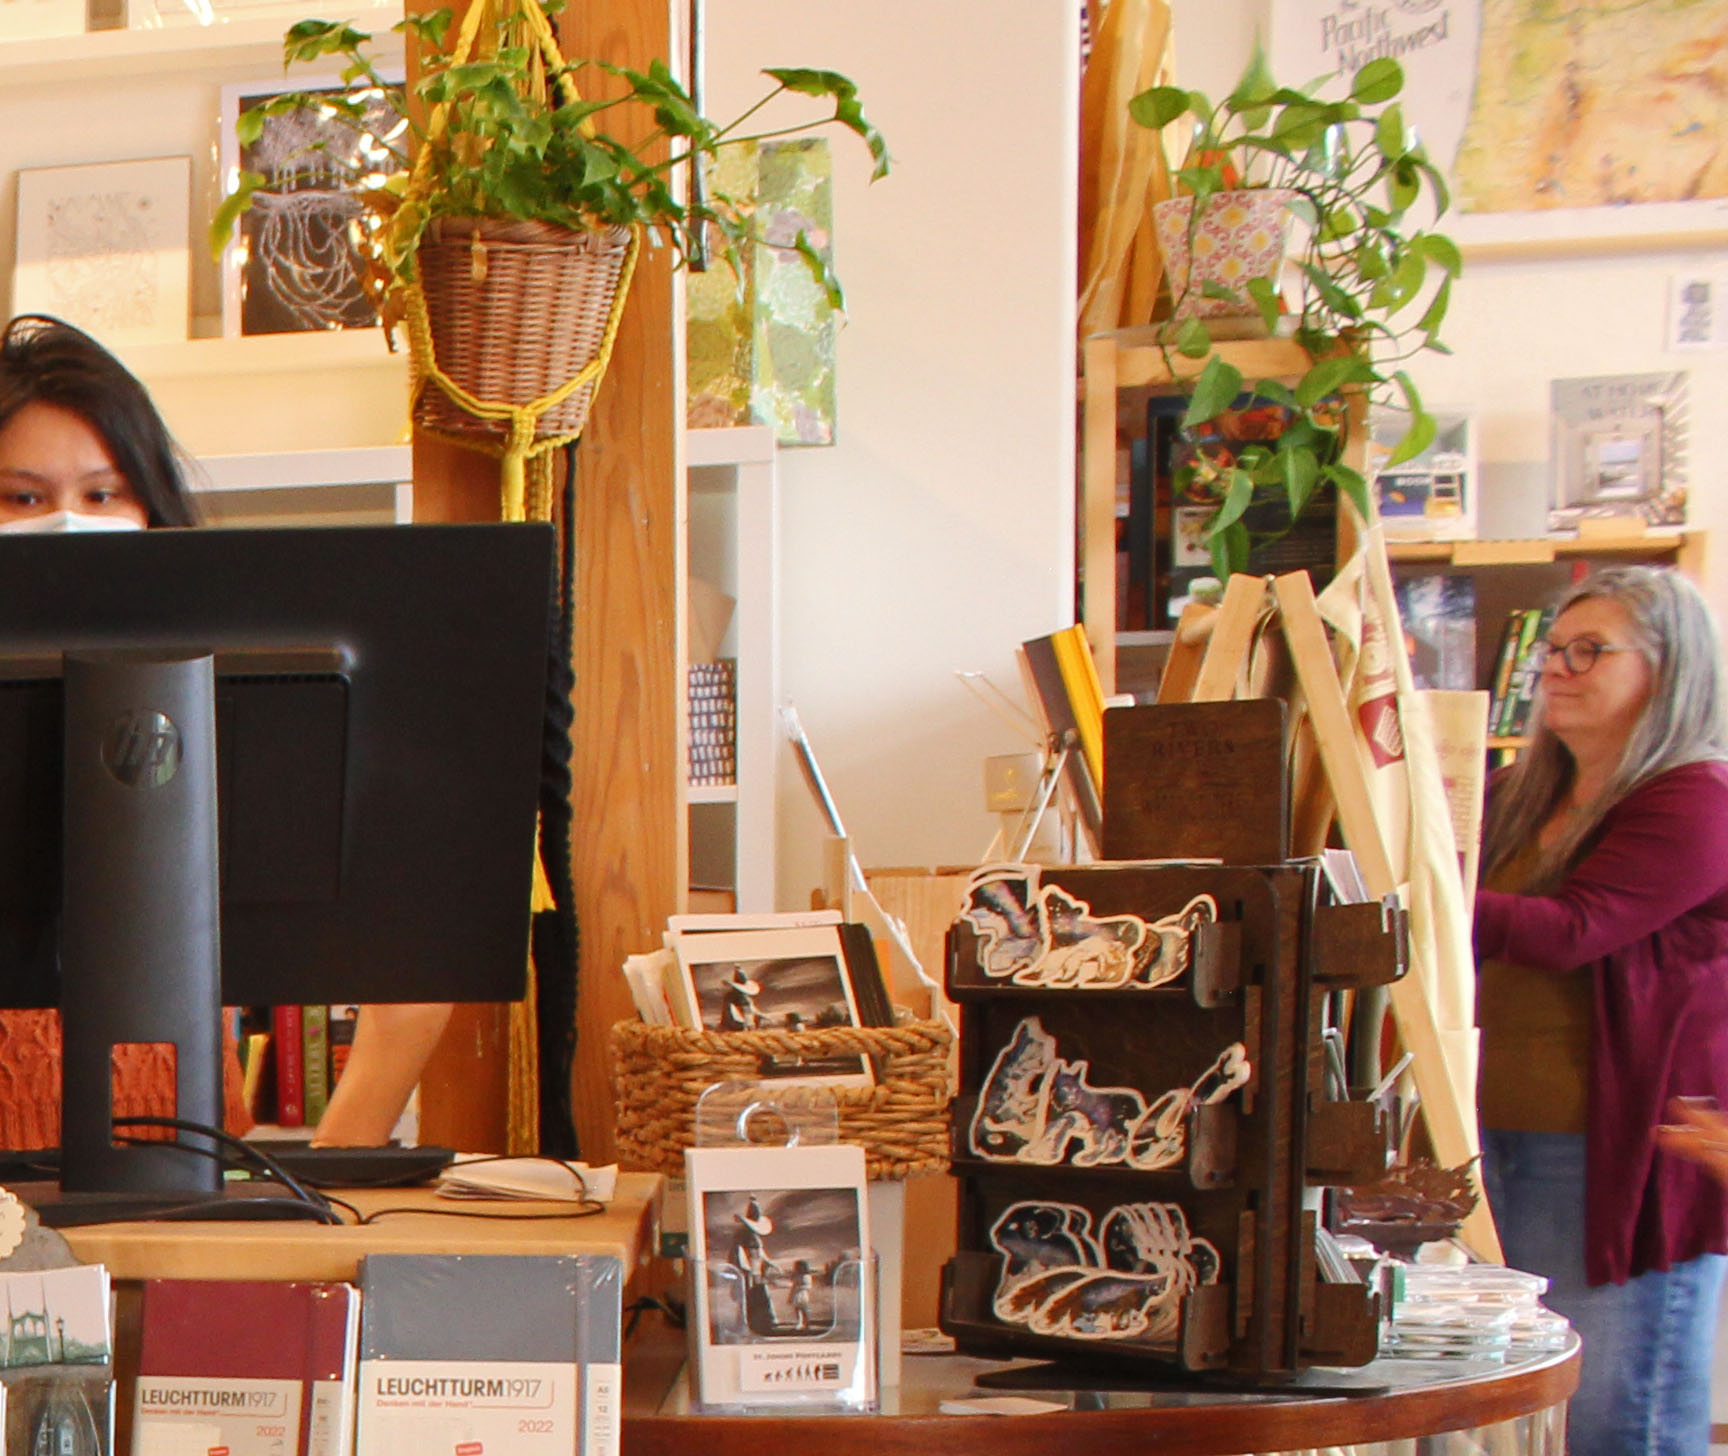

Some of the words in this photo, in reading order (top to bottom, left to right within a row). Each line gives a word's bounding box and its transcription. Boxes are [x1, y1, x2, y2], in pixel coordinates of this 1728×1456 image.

[376, 1377, 542, 1398] LEUCHTTURM1917
[141, 1388, 278, 1408] LEUCHTTURM1917
[256, 1425, 286, 1438] 2022
[517, 1419, 554, 1434] 2022
